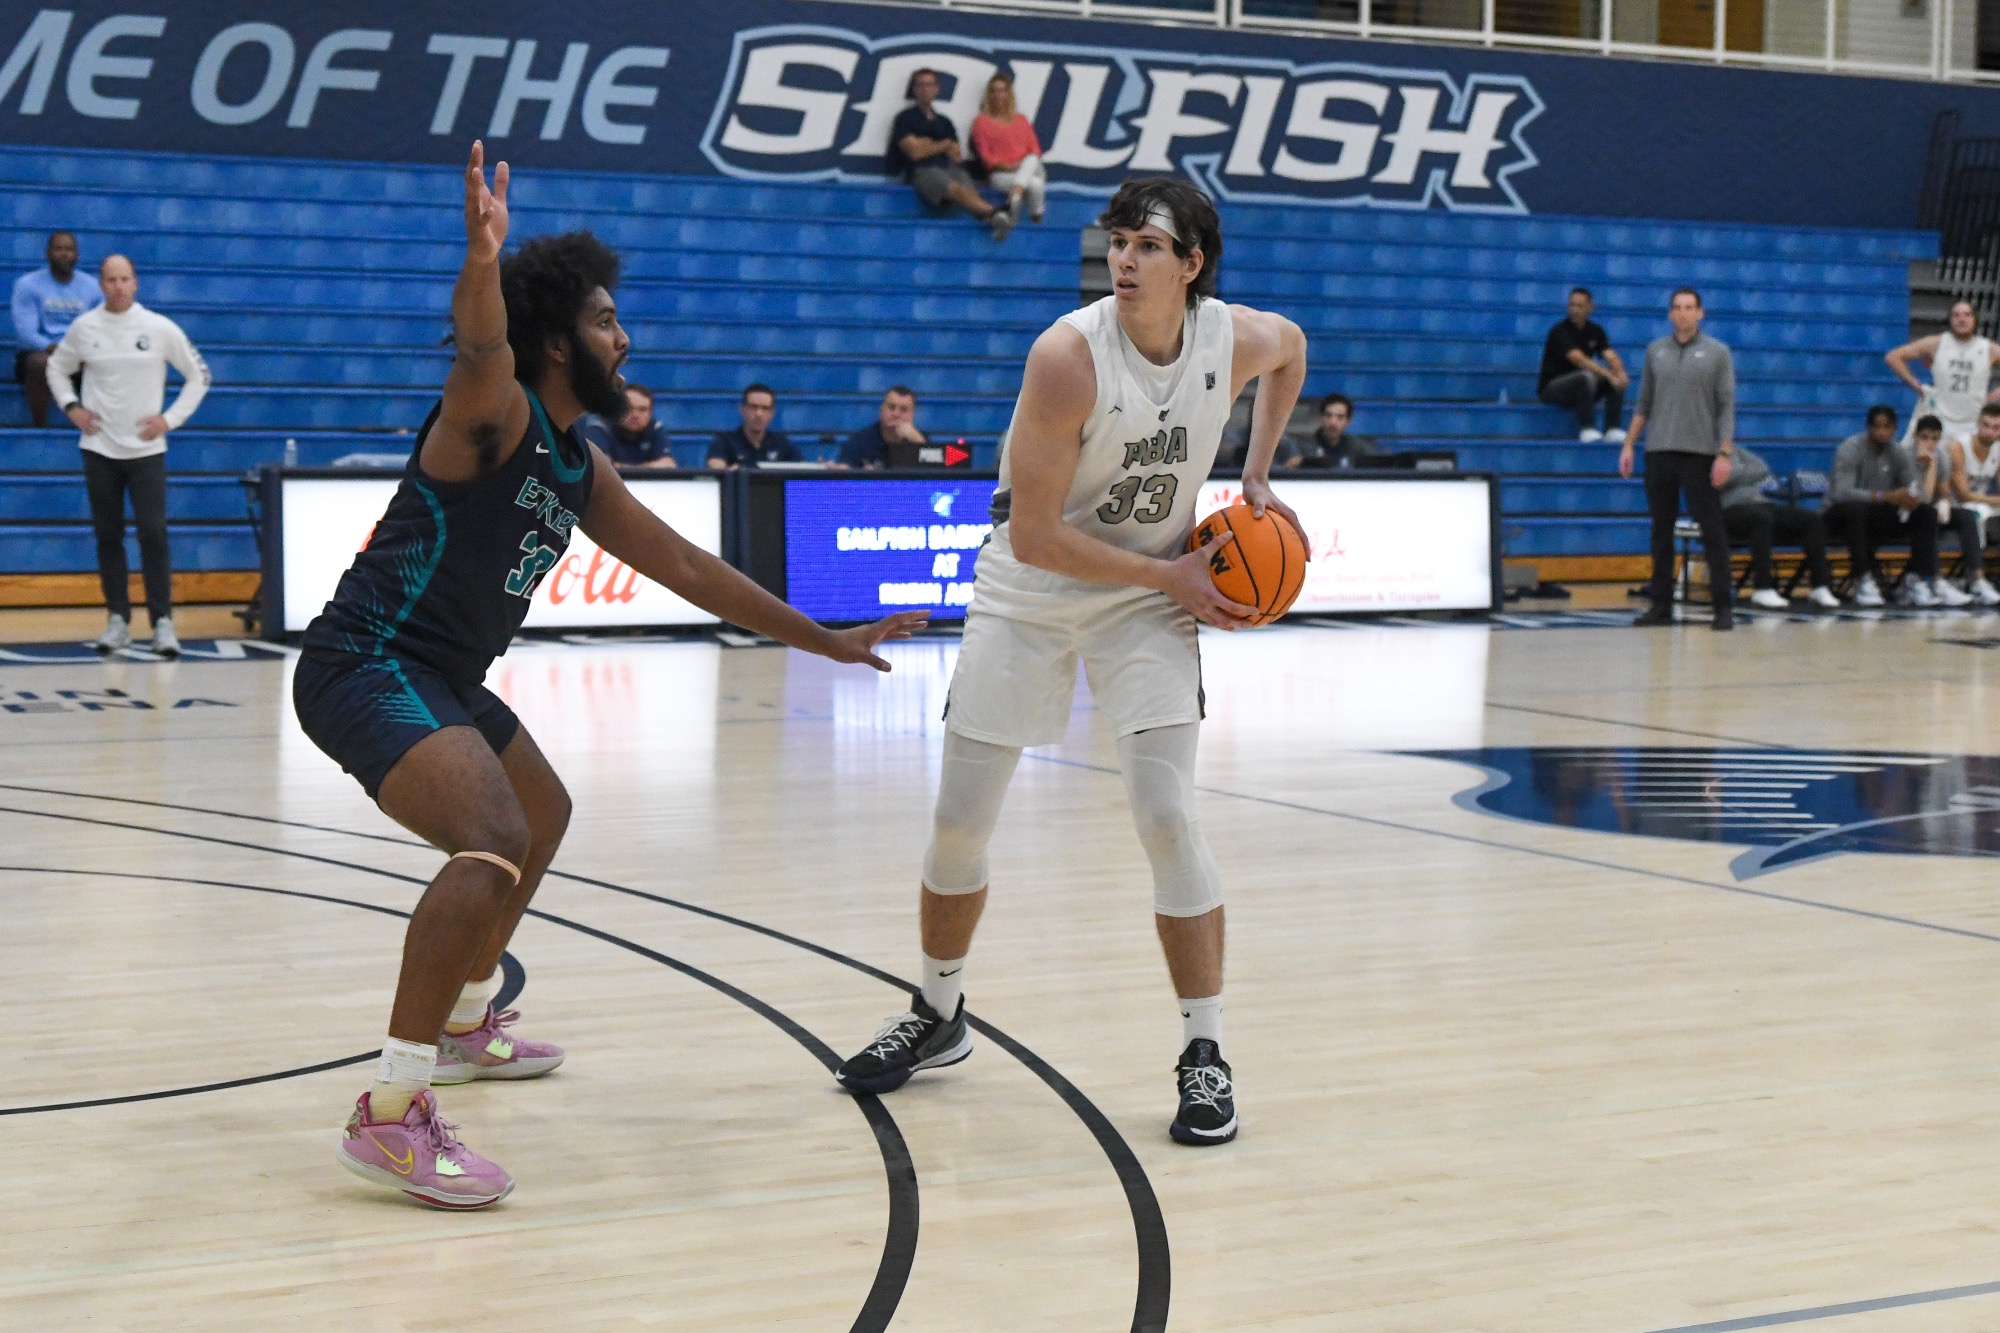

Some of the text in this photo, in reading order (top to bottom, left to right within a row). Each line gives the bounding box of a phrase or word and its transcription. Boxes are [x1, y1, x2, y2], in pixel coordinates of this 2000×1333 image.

[190, 22, 393, 129] OF
[426, 34, 670, 144] THE
[1122, 426, 1188, 470] PBA
[1096, 473, 1178, 524] 33
[547, 545, 637, 606] ola
[932, 552, 960, 578] AT
